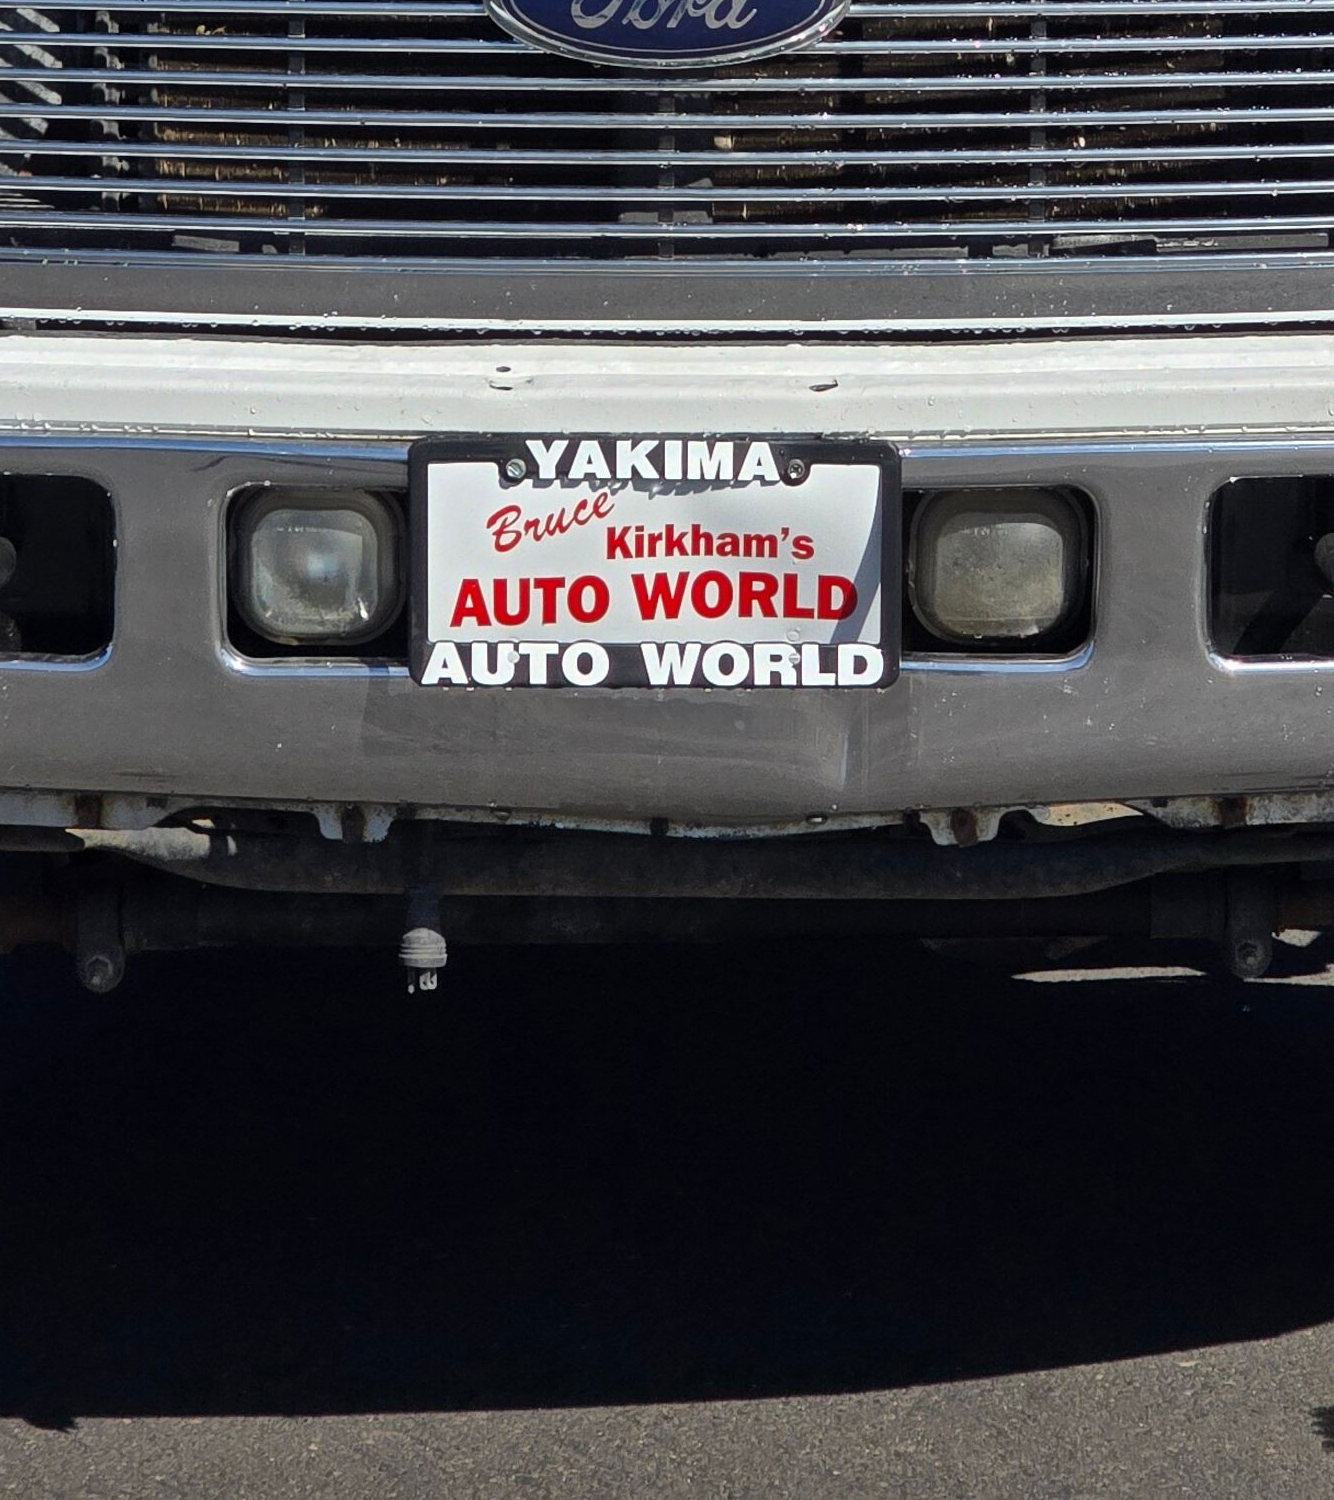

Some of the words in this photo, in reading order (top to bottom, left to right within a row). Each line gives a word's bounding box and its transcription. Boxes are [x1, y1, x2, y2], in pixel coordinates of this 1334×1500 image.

[525, 439, 781, 482] YAKIMA
[486, 491, 616, 553] Bruce
[606, 523, 815, 561] Kirkham's
[450, 575, 610, 628] AUTO
[631, 569, 859, 621] WORLD
[421, 642, 610, 686] AUTO
[640, 642, 884, 687] WORLD
